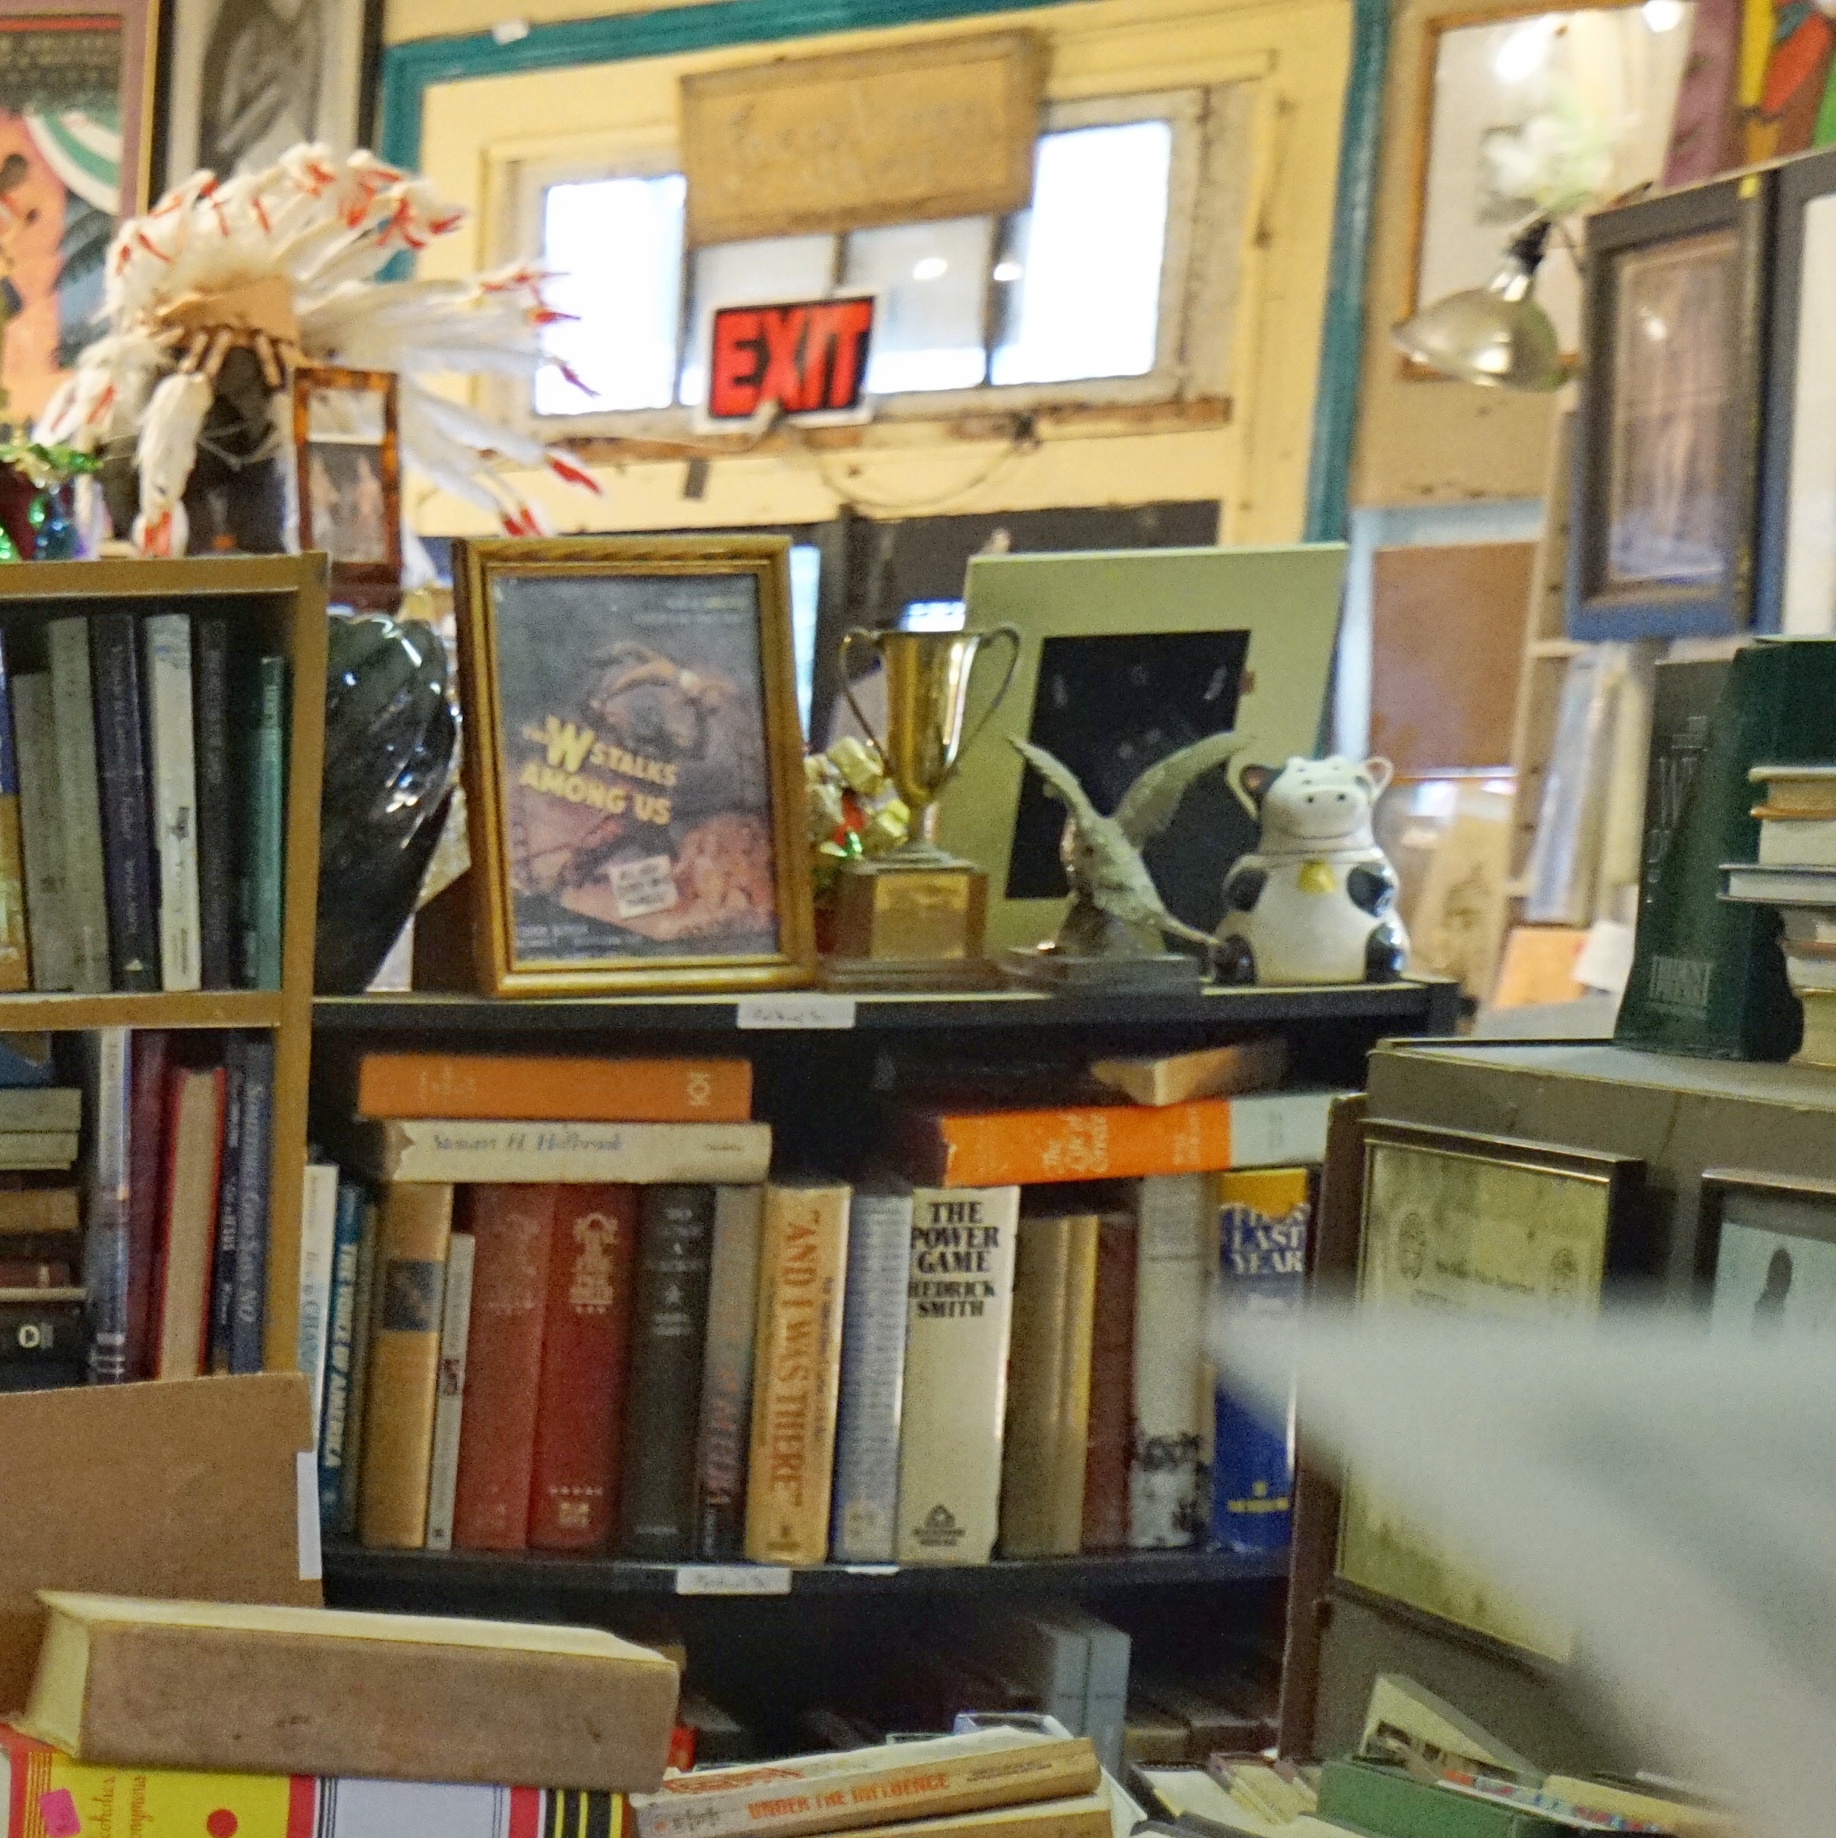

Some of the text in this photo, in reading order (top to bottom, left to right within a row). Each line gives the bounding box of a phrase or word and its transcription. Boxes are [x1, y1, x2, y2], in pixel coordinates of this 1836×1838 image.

[722, 303, 869, 413] EXIT
[590, 742, 678, 787] STALKS
[519, 762, 672, 825] AMONG US
[926, 1202, 983, 1224] THE
[911, 1226, 999, 1249] POWER
[918, 1250, 991, 1274] GAME
[917, 1300, 984, 1318] SMITH
[748, 1795, 808, 1820] UNDER
[815, 1789, 846, 1808] THE
